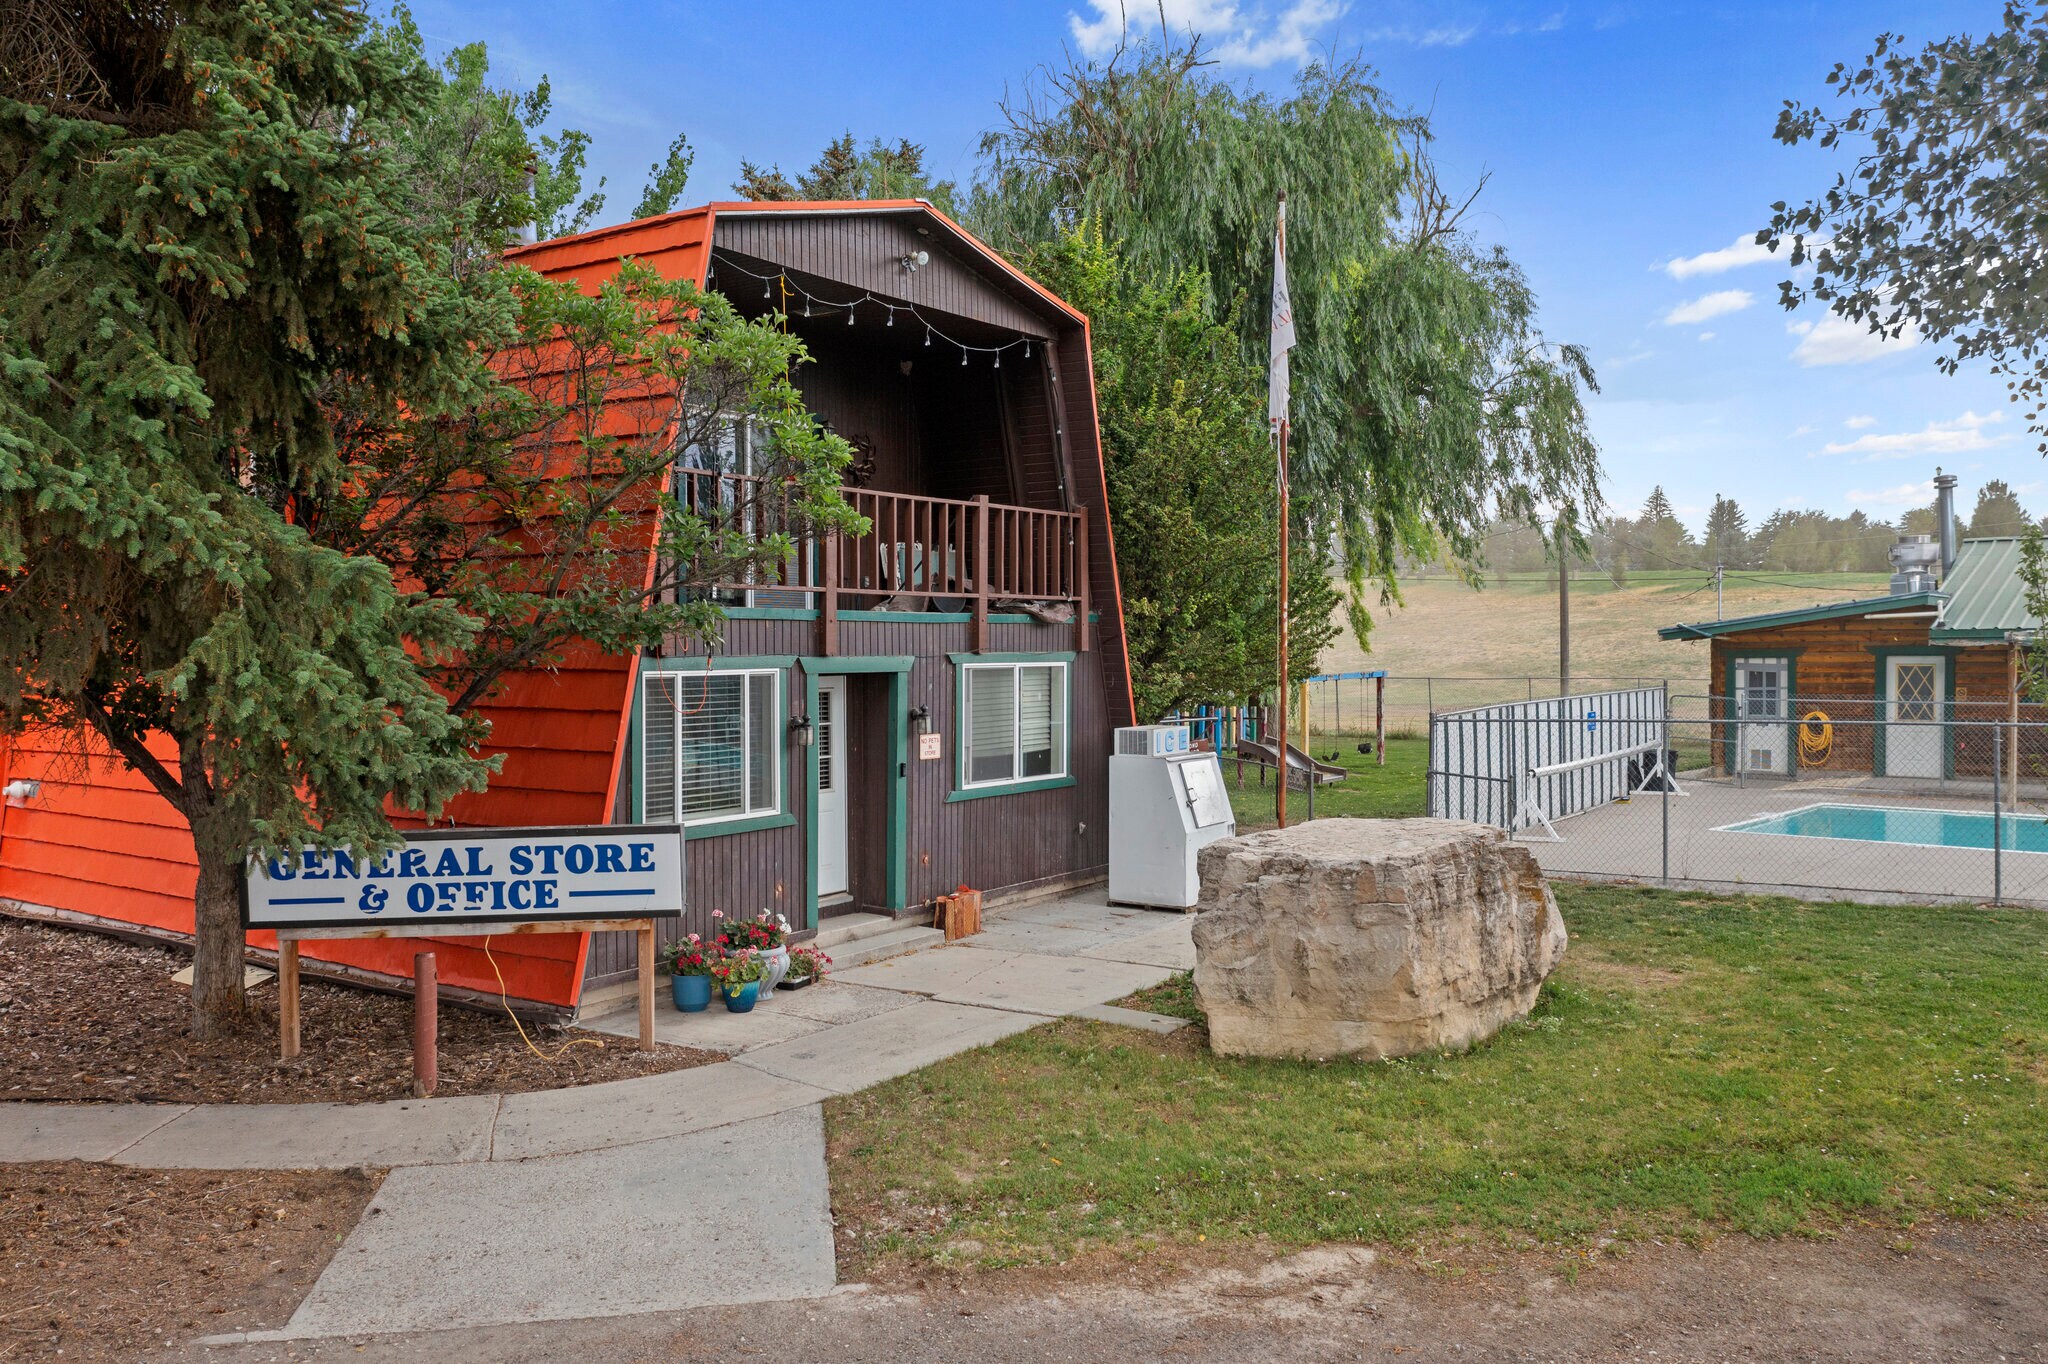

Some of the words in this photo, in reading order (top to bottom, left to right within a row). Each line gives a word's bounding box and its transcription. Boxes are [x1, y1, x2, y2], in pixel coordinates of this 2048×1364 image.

[1156, 729, 1187, 753] ICE
[268, 847, 494, 881] GENERAL
[509, 843, 656, 876] STORE
[358, 884, 389, 914] &
[406, 879, 559, 913] OFFICE
